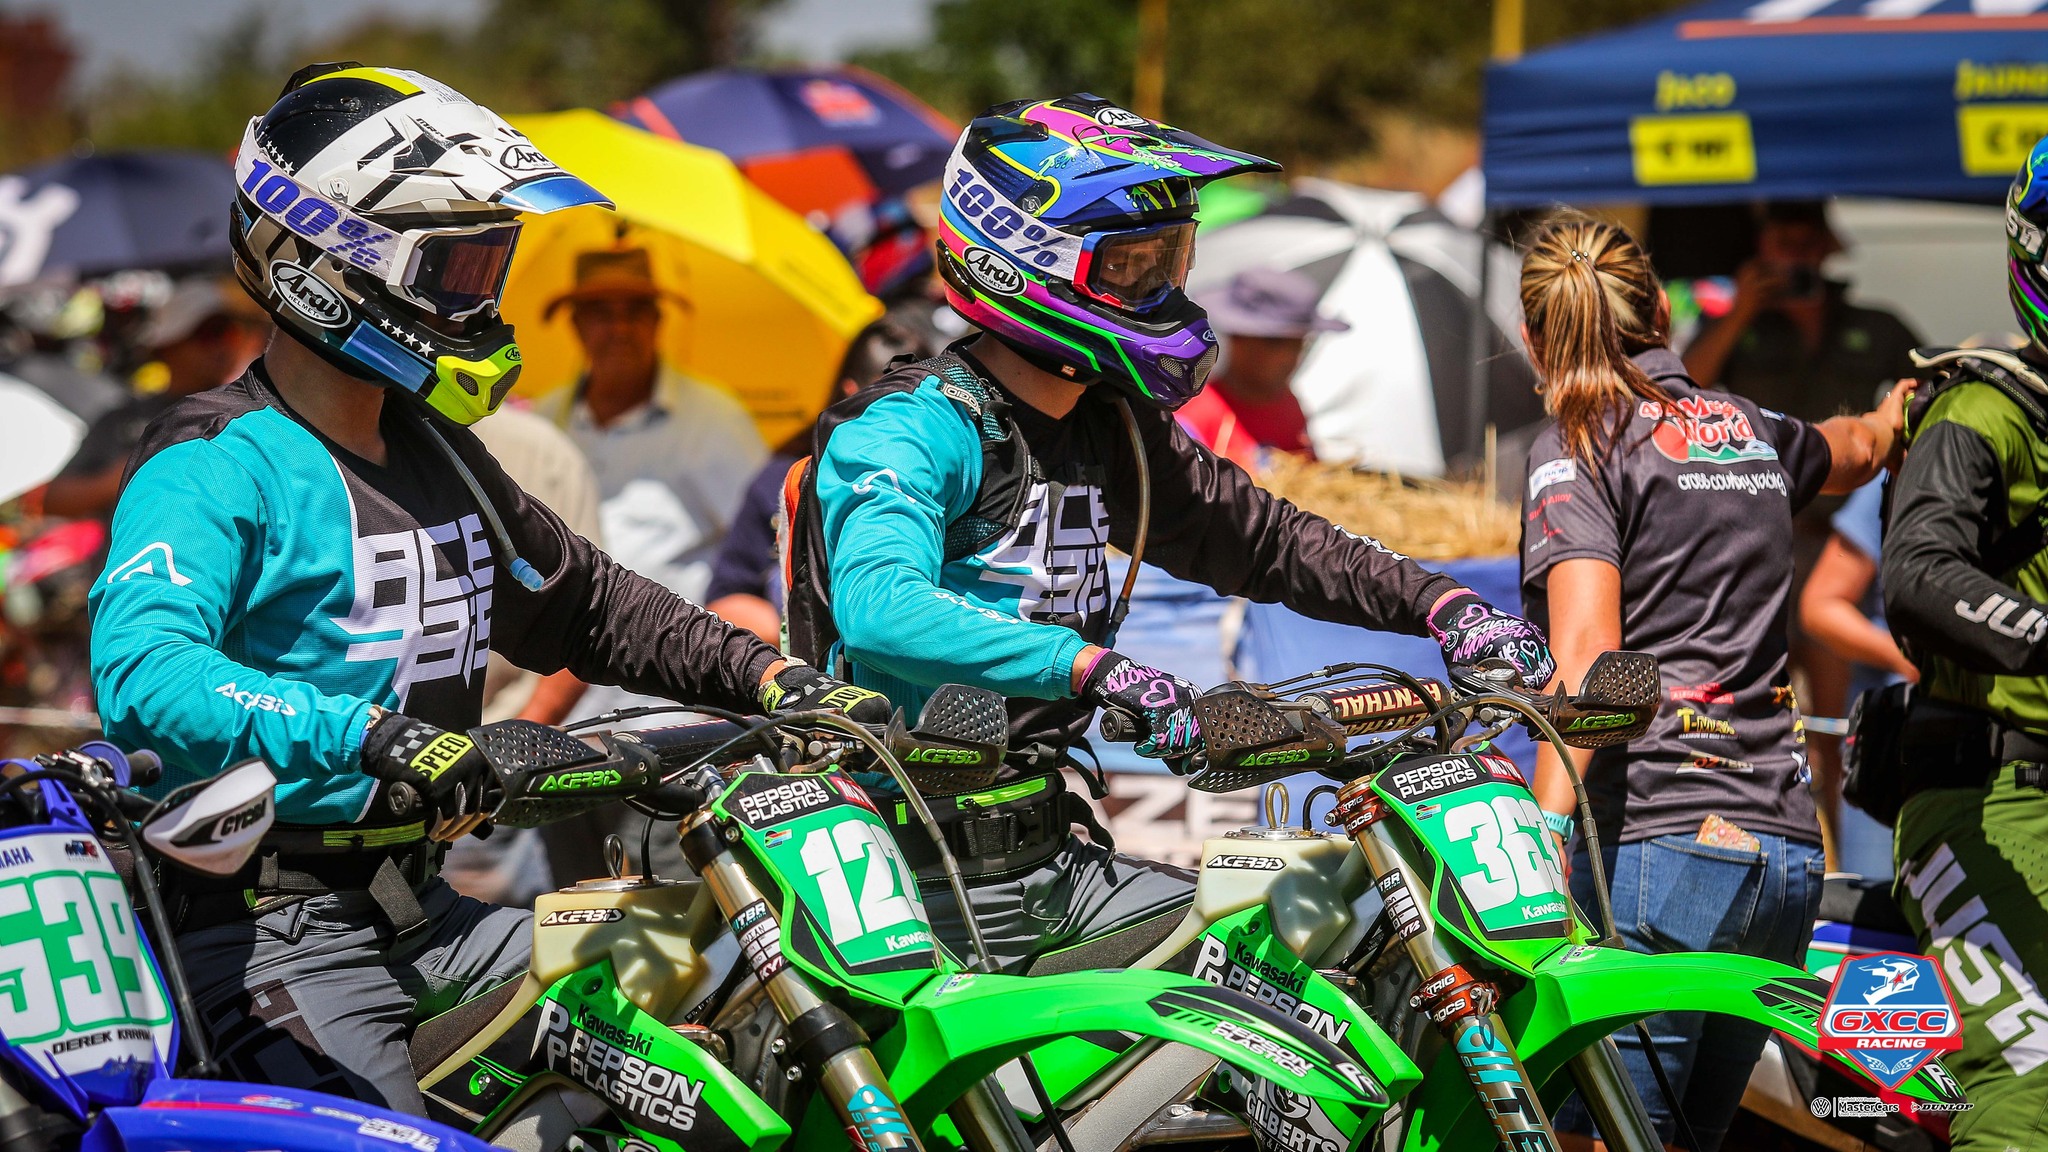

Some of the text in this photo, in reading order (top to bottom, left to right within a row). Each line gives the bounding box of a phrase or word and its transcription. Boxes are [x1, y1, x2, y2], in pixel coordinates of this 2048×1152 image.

[513, 148, 549, 168] Ara
[242, 158, 393, 270] 100%
[949, 168, 1066, 267] 100%
[967, 254, 1019, 287] Arai
[273, 273, 341, 316] Arai
[288, 293, 318, 318] HELMET
[1678, 472, 1710, 491] cross
[1463, 625, 1532, 659] YOURSELF
[1465, 619, 1525, 642] BELIEVE
[413, 734, 468, 779] SPEED
[905, 747, 982, 765] ACERBIS
[1239, 748, 1309, 767] ACERBIS
[1392, 758, 1471, 788] PEPSON
[540, 769, 622, 792] ACERBIS
[738, 778, 822, 813] PEPSON
[1400, 768, 1478, 799] PLASTICS
[746, 789, 830, 825] PLASTICS
[1207, 855, 1285, 870] ACERBIS
[542, 908, 622, 926] ACERBIS
[738, 901, 766, 926] TBR
[0, 872, 168, 1040] 539
[1235, 942, 1306, 994] Kawasaki
[1226, 965, 1350, 1044] PEPSON
[53, 1031, 112, 1055] DEREK
[577, 1003, 654, 1056] Kawasaki
[1214, 1020, 1315, 1069] PEPSON
[570, 1028, 705, 1108] PEPSON
[1211, 1028, 1309, 1078] PLASTICS
[570, 1056, 697, 1132] PLASTICS
[1246, 1091, 1340, 1152] GILBERTS
